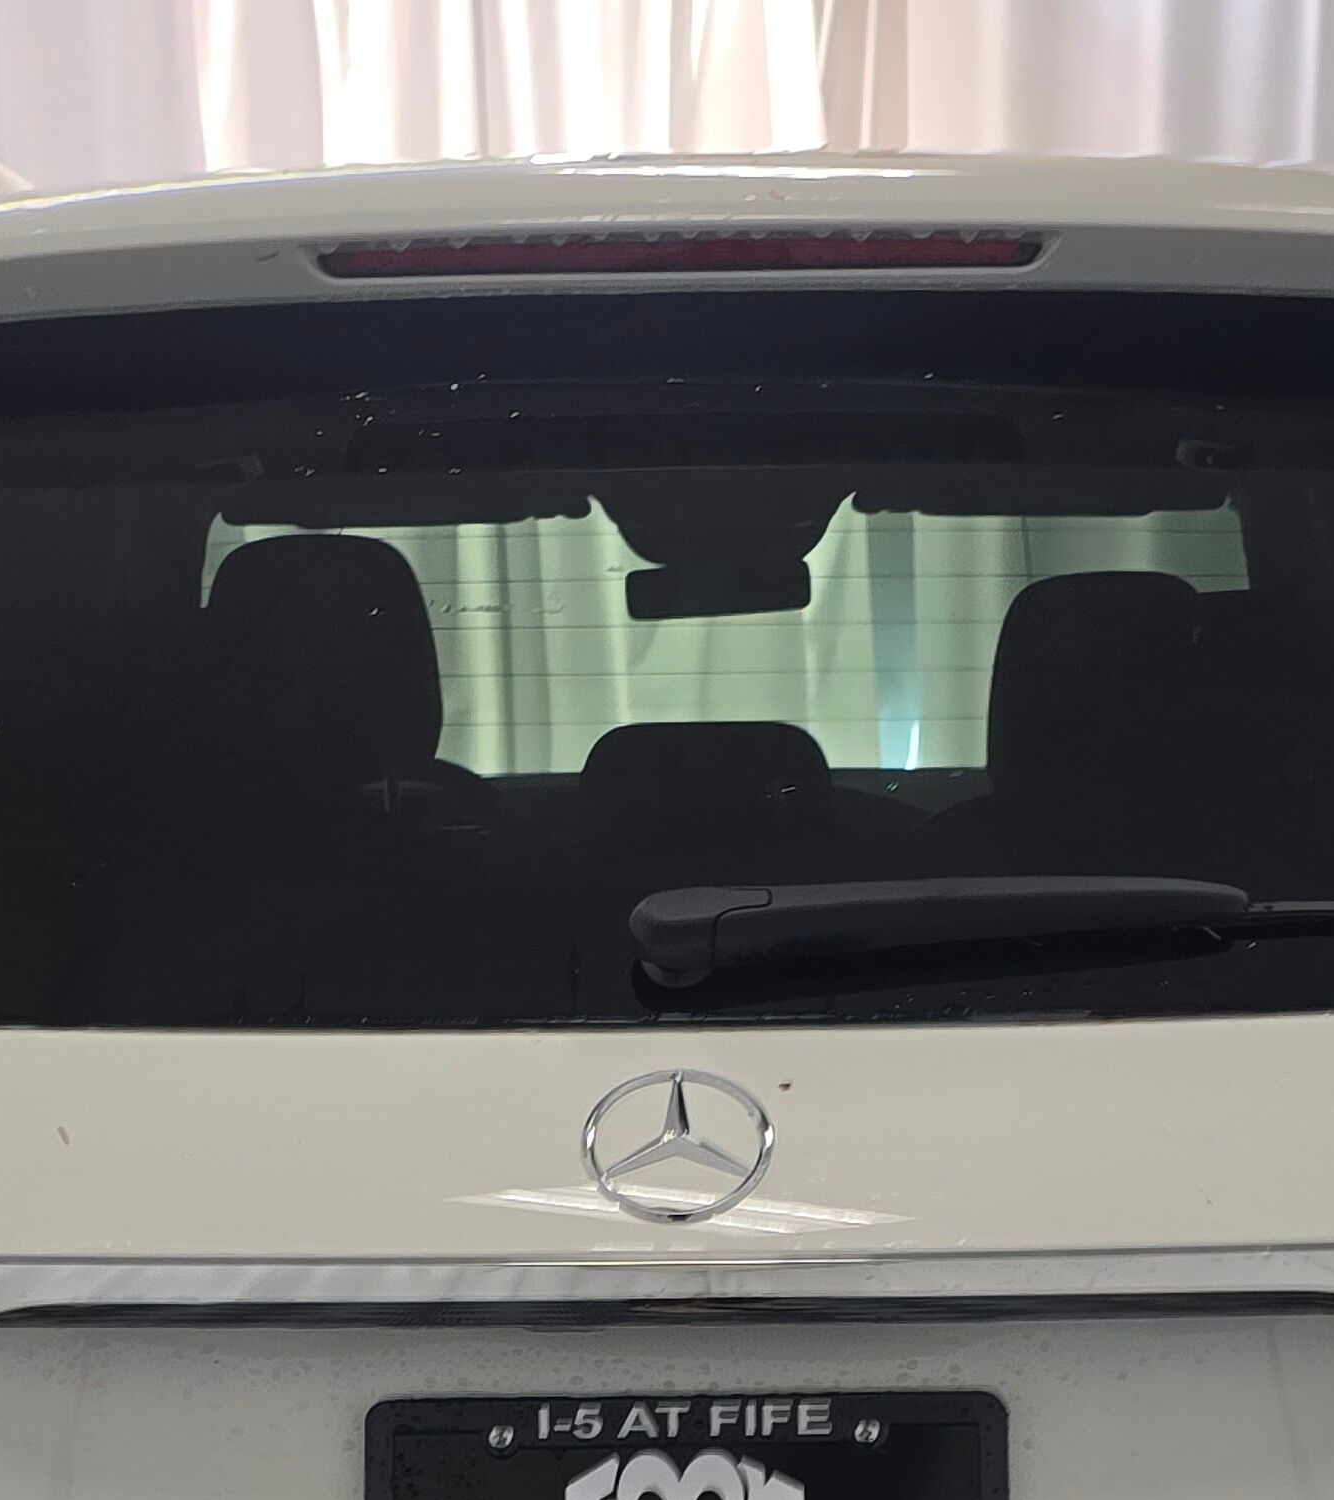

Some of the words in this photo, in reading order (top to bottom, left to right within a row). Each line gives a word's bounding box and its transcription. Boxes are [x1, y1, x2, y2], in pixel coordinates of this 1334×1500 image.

[536, 1402, 603, 1440] I-5
[618, 1404, 690, 1439] AT
[709, 1399, 834, 1437] FIFE
